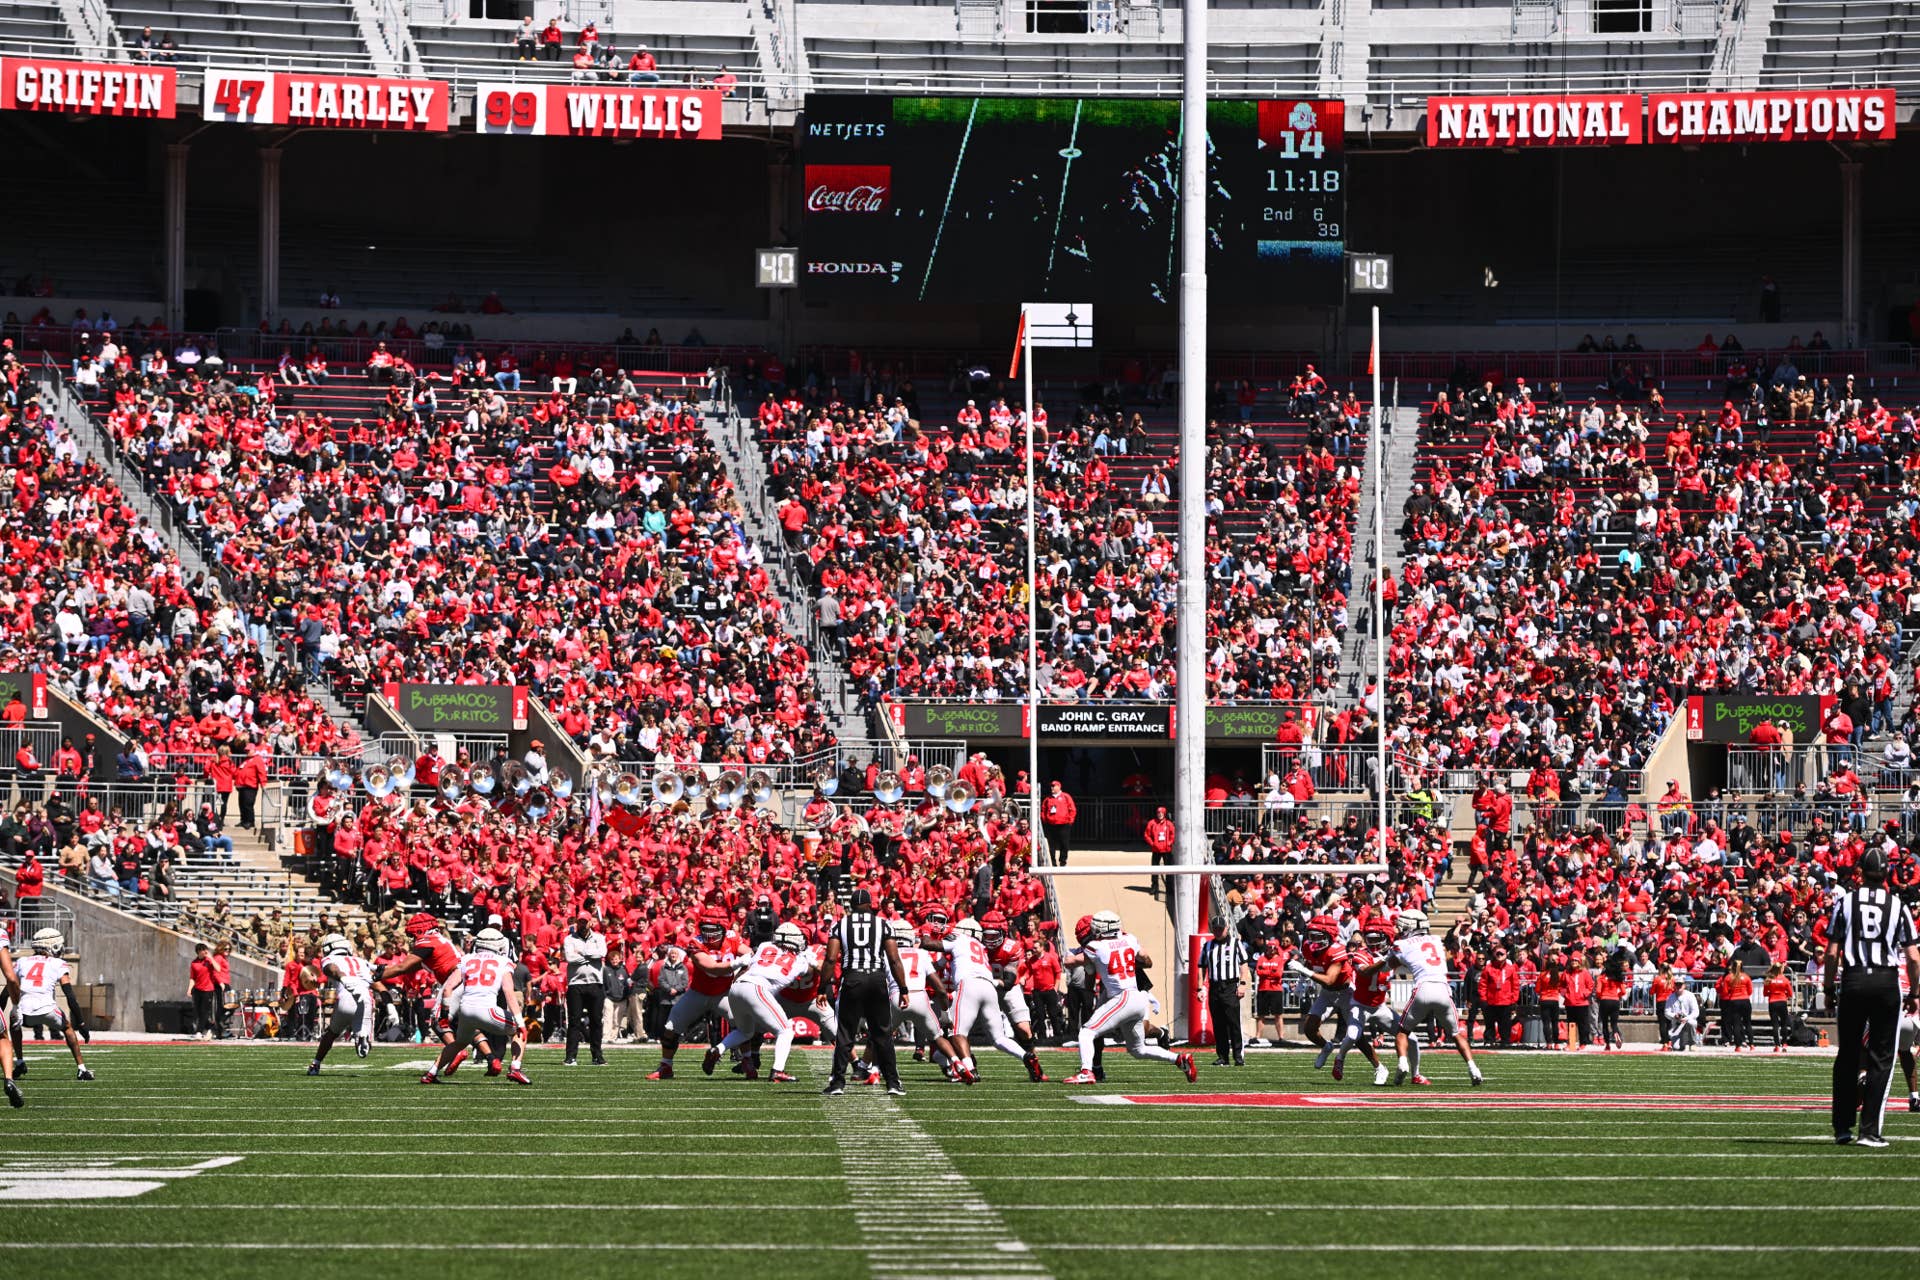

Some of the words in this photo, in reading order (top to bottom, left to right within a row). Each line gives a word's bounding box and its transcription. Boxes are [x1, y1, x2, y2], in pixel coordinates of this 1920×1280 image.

[17, 66, 164, 110] GRIFFIN
[215, 79, 265, 114] 47
[290, 81, 435, 123] HARLEY
[486, 91, 537, 127] 99
[567, 93, 703, 131] WILLIS
[1439, 101, 1629, 139] NATIONAL
[1657, 97, 1885, 134] CHAMPIONS
[810, 123, 886, 140] NETJETS
[1280, 131, 1325, 159] 14
[1267, 170, 1339, 191] 11:18
[1263, 208, 1293, 221] 2nd
[1313, 208, 1323, 221] 6
[1318, 224, 1339, 236] 39
[760, 253, 794, 283] 40
[808, 262, 887, 273] HONDA
[1355, 259, 1388, 289] 40
[1058, 712, 1092, 722] JOHN
[1096, 712, 1108, 721] C.
[1111, 712, 1146, 722] GRAY
[1715, 702, 1804, 721] BUBBAKOO'S
[1041, 724, 1071, 732] BAND
[1074, 724, 1105, 732] RAMP
[1108, 724, 1165, 733] ENTRANCE
[852, 923, 870, 946] U
[1860, 904, 1883, 939] B
[758, 946, 797, 976] 94
[1107, 947, 1136, 980] 48
[1420, 942, 1441, 966] 3
[25, 962, 45, 987] 4
[466, 959, 499, 987] 26
